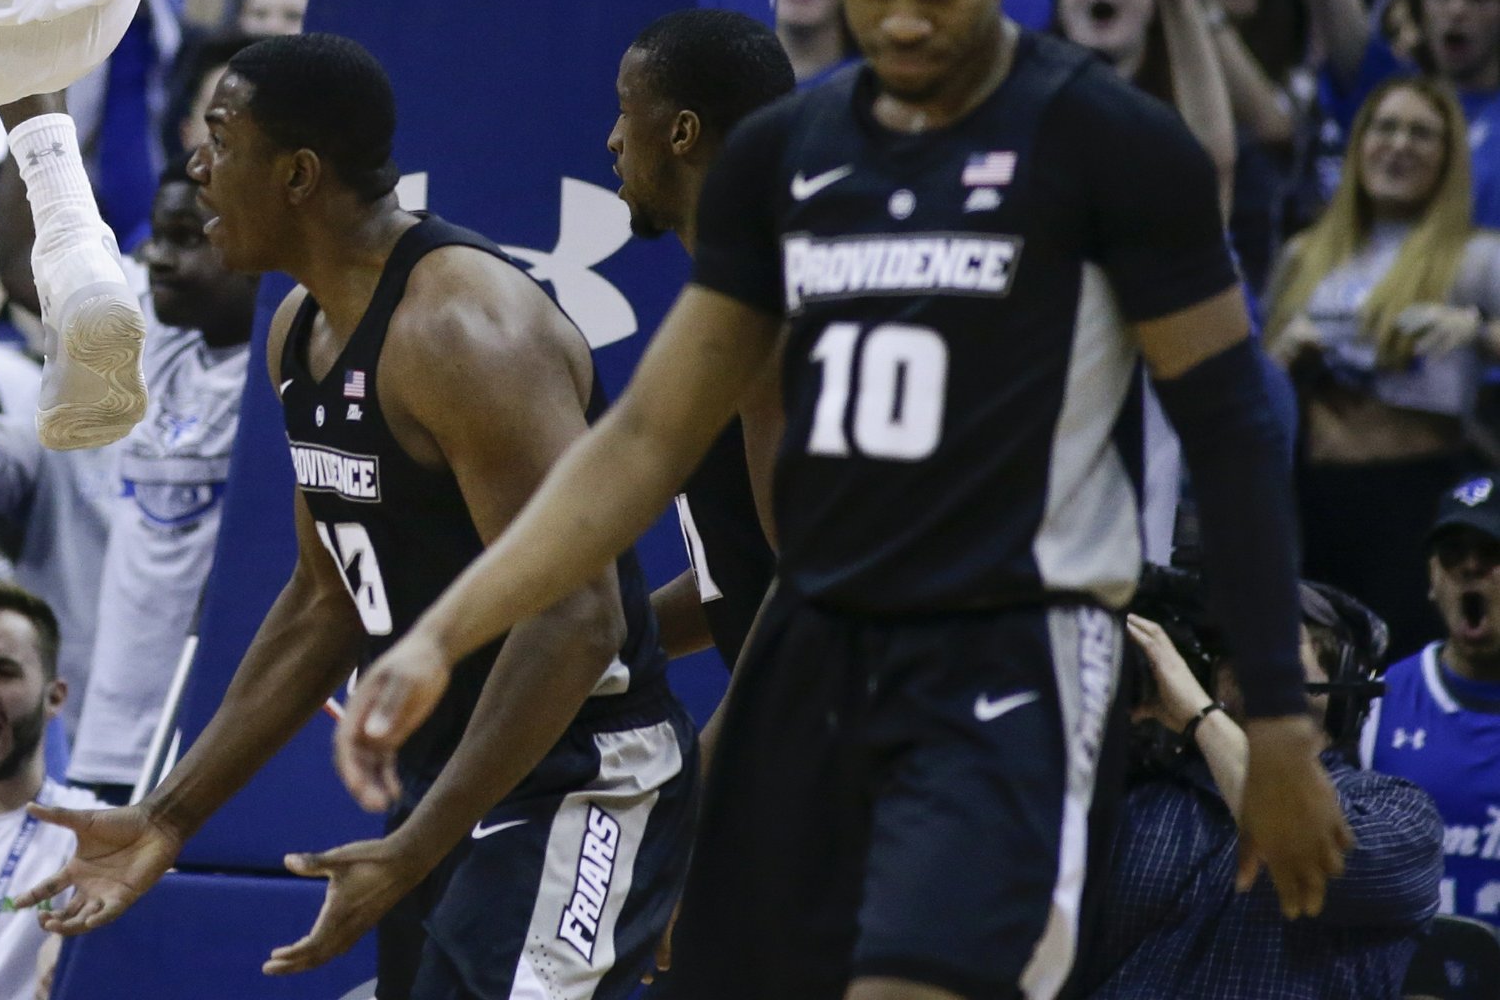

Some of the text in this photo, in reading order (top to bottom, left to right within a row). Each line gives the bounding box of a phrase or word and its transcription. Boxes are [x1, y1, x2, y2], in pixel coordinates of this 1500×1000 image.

[783, 237, 1015, 314] PROVIDENCE
[807, 321, 949, 462] 10
[289, 445, 378, 499] ROVIDENCE
[557, 802, 622, 965] FRIARS
